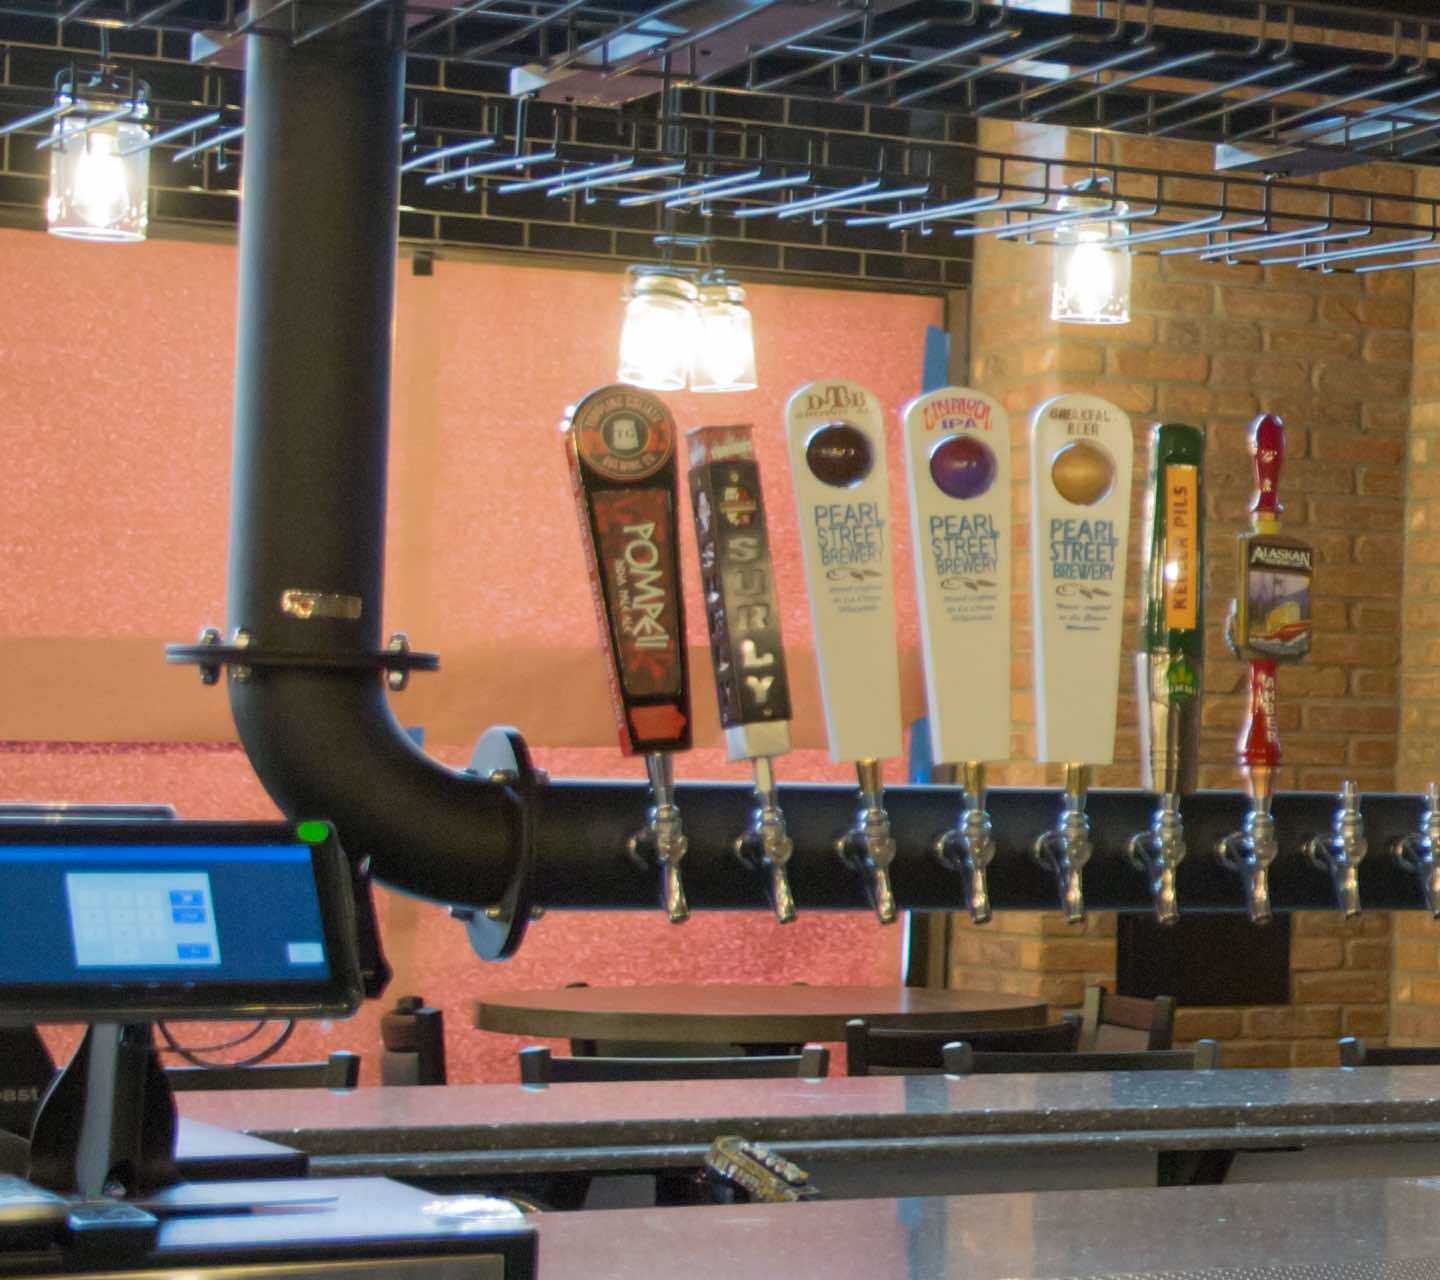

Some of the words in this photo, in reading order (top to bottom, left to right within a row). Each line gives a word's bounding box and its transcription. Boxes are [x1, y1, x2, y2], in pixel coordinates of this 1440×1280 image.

[941, 418, 978, 429] IPA
[814, 503, 883, 528] PEARL
[1174, 485, 1188, 528] PILS
[817, 524, 883, 548] STREET
[930, 514, 998, 539] PEARL
[1050, 519, 1118, 541] PEARL
[821, 544, 883, 566] BREWERY
[932, 535, 997, 558] STREET
[1050, 541, 1118, 562] STREET
[1250, 546, 1311, 568] ALASKAN
[936, 556, 998, 577] BREWERY
[1053, 563, 1115, 580] BREWERY
[727, 537, 776, 703] SURLY
